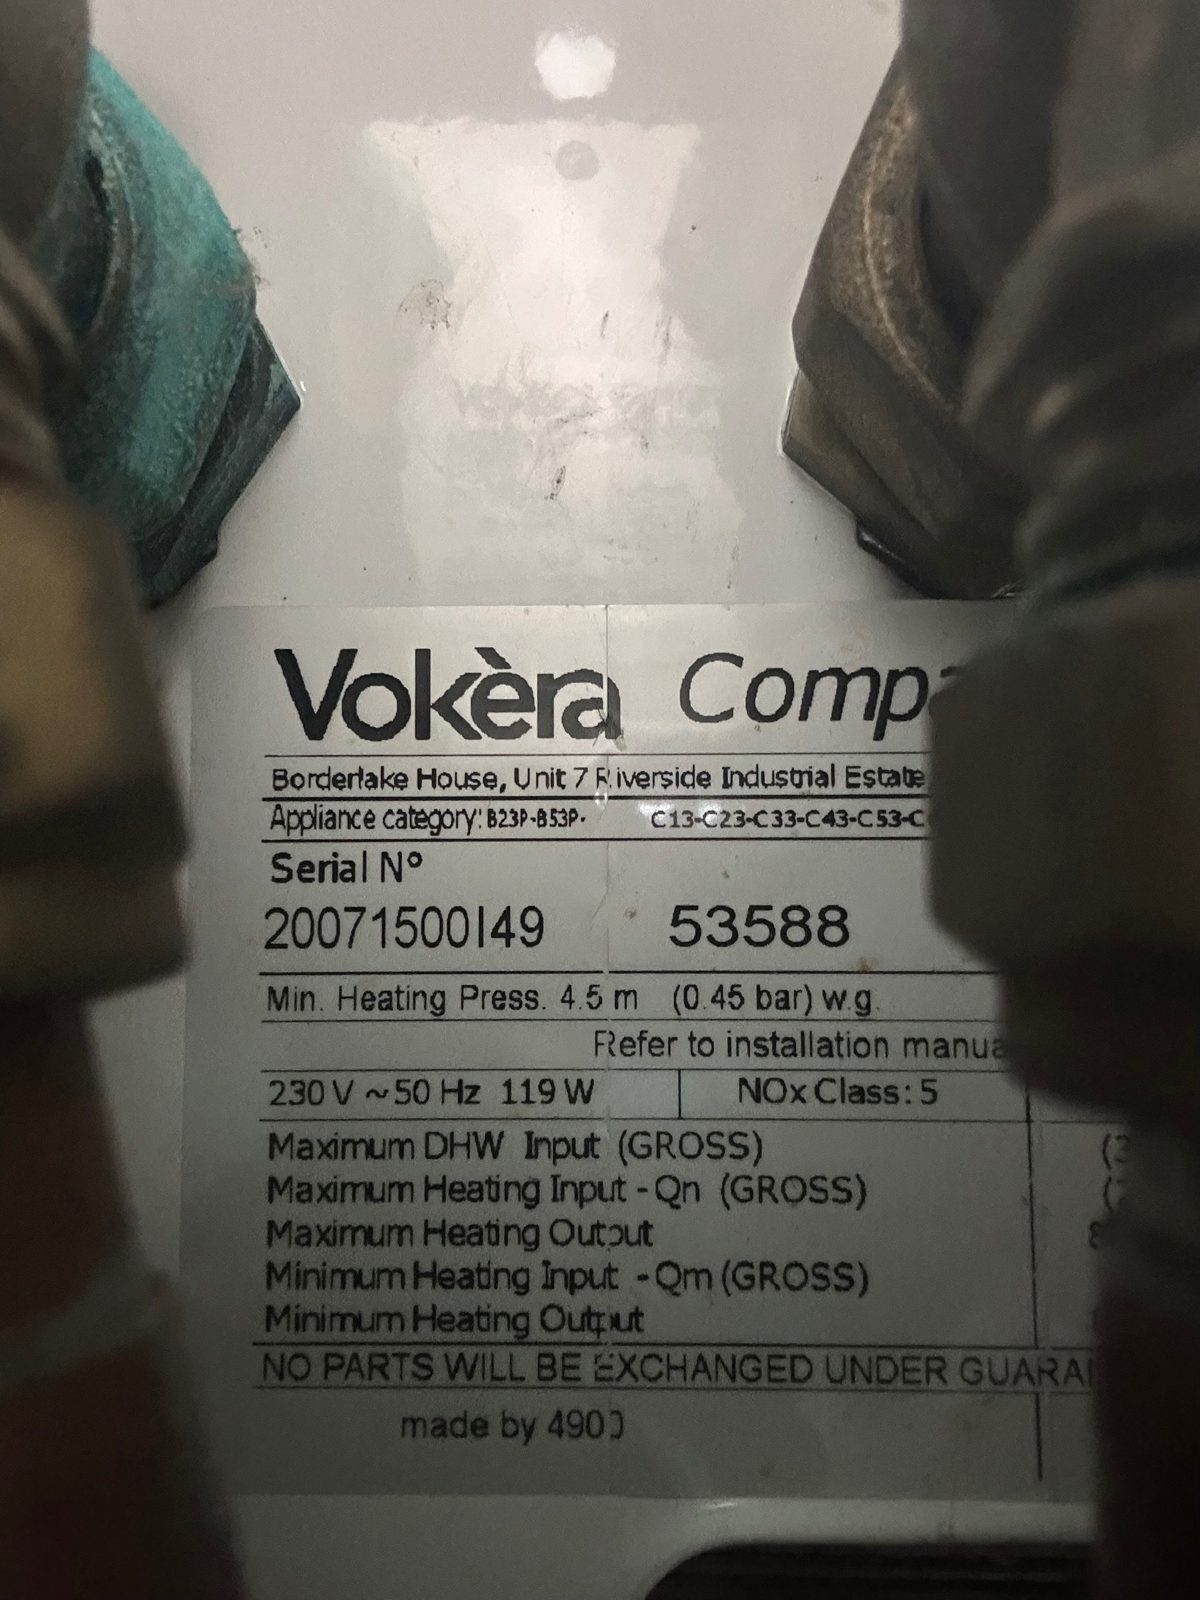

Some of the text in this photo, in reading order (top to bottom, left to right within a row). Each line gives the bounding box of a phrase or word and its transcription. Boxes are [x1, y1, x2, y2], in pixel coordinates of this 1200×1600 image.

[272, 645, 957, 742] Vokèra Comp
[415, 765, 507, 794] House,
[512, 765, 567, 791] Unit
[572, 766, 589, 790] 7
[594, 764, 712, 791] Riverside
[720, 763, 836, 790] Industrial
[844, 763, 927, 790] Estate
[269, 802, 376, 836] Appliance
[270, 850, 368, 884] Serial
[668, 903, 850, 948] 53588
[266, 984, 325, 1013] Min.
[337, 982, 447, 1017] Heating
[459, 982, 547, 1013] Press.
[559, 981, 603, 1012] 4.5
[613, 988, 638, 1011] m
[672, 982, 745, 1017] (0.45
[755, 982, 813, 1017] bar)
[593, 1028, 1008, 1060] Refer to installation manua
[268, 1078, 326, 1107] 230
[332, 1078, 354, 1107] V
[440, 1078, 482, 1107] Hz
[501, 1077, 556, 1106] 119
[564, 1077, 596, 1106] W
[737, 1076, 939, 1107] NOx Class: 5
[267, 1129, 763, 1168] Maximum DHW Input (GROSS)
[267, 1174, 416, 1205] Maximum
[423, 1173, 541, 1211] Heating
[551, 1173, 628, 1210] Input
[720, 1172, 868, 1212] (GROSS)
[266, 1218, 416, 1249] Maximum
[423, 1217, 541, 1253] Heating
[265, 1259, 406, 1291] Minimum
[413, 1259, 532, 1297] Heating
[541, 1259, 620, 1297] Input
[722, 1259, 870, 1299] (GROSS)
[265, 1303, 645, 1341] Minimum Heating Output
[263, 1352, 1096, 1390] NO PARTS WILL BE EXCHANGED UNDER GUARA
[401, 1409, 491, 1440] made
[500, 1409, 537, 1446] by
